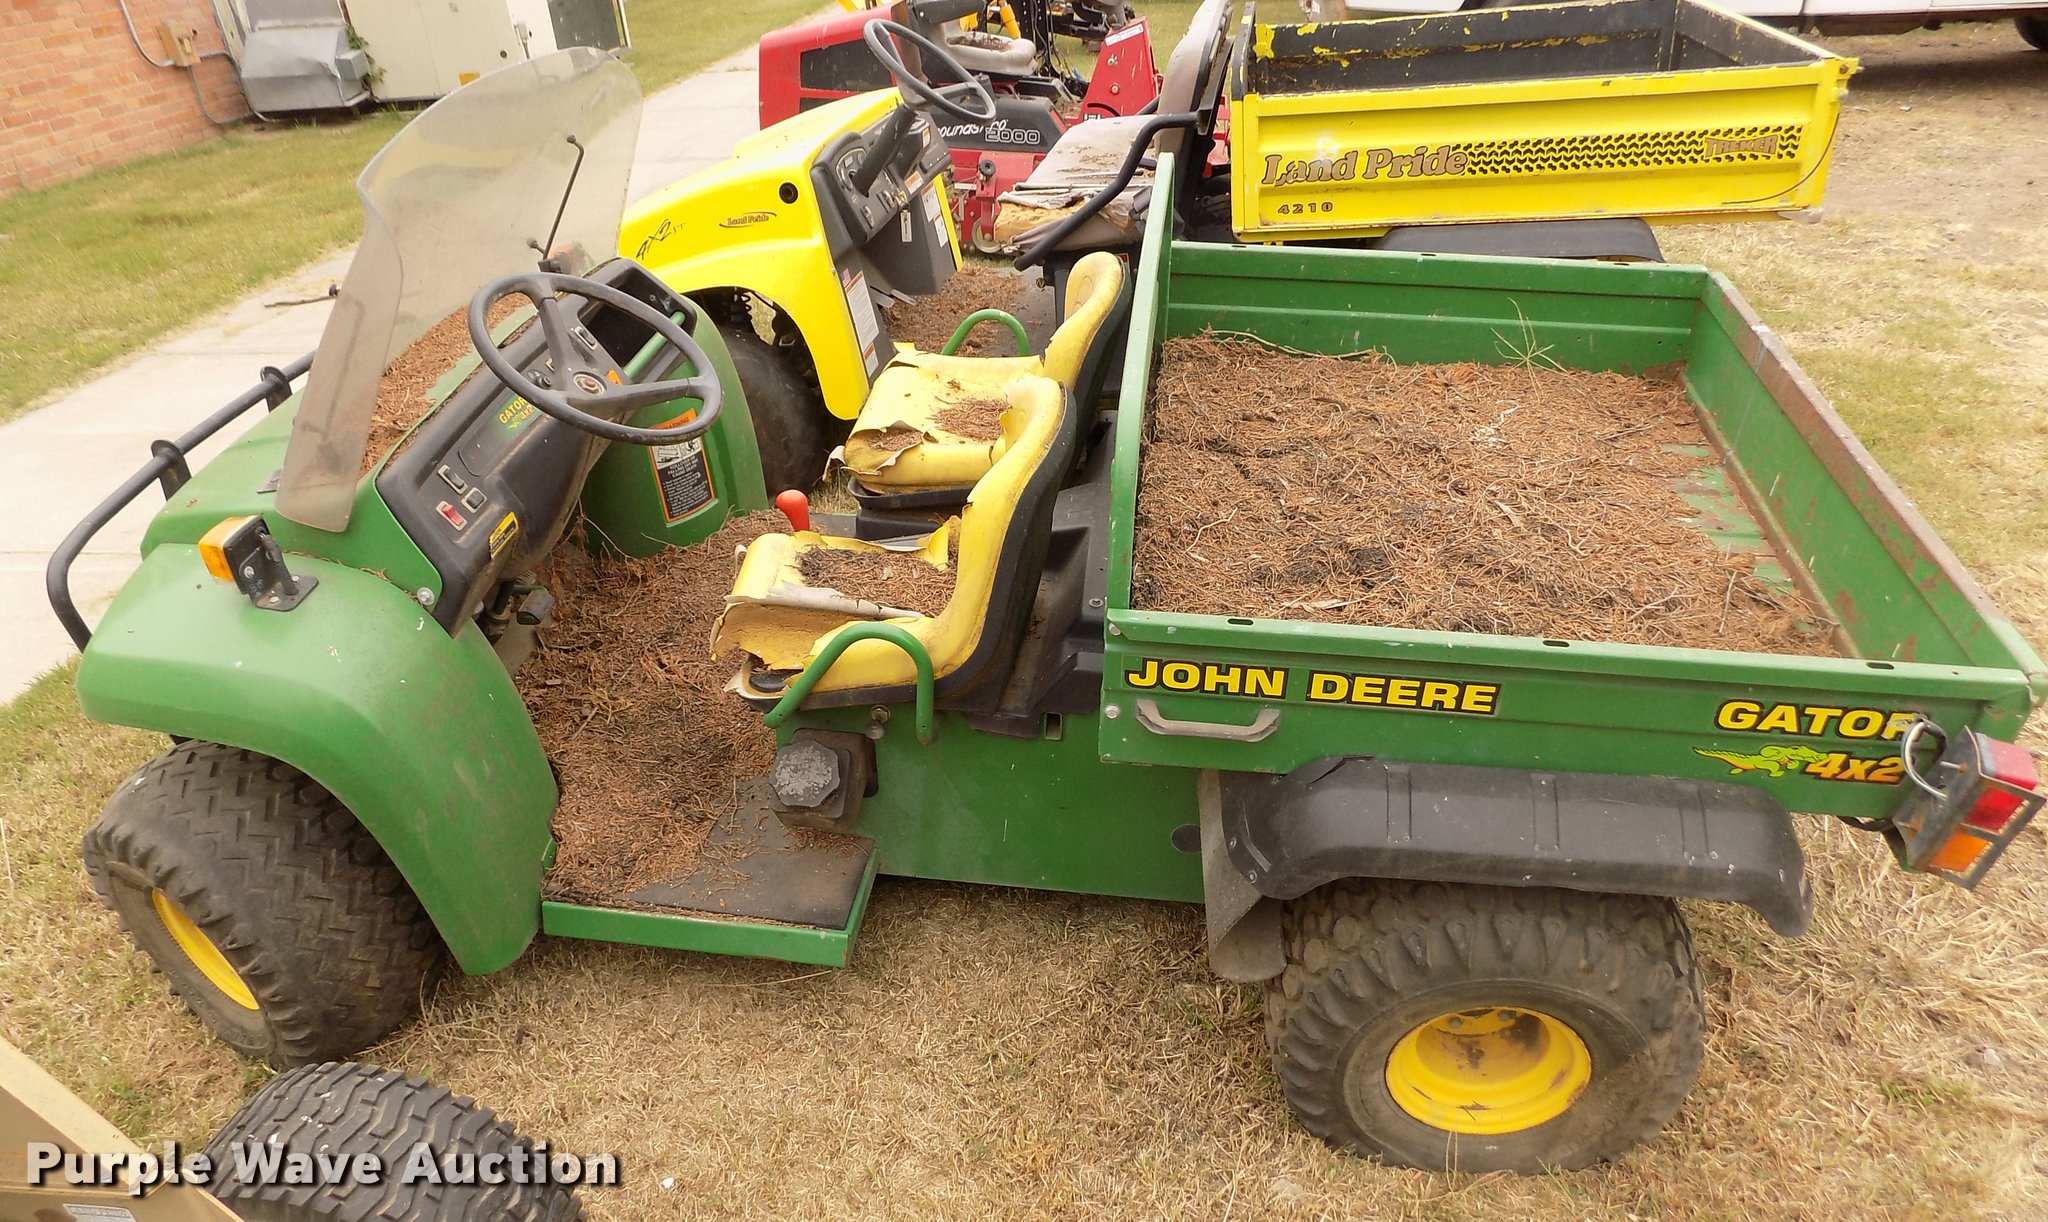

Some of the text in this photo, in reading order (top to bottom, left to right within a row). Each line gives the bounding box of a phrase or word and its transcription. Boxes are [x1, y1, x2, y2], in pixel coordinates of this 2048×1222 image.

[984, 127, 1040, 145] 2000
[1704, 134, 1778, 158] TREKER
[1261, 145, 1469, 187] Land Pride
[727, 212, 770, 226] Land Pride
[1277, 201, 1333, 214] 4210
[1126, 658, 1499, 714] JOHN DEERE
[1803, 752, 1908, 784] 4x2
